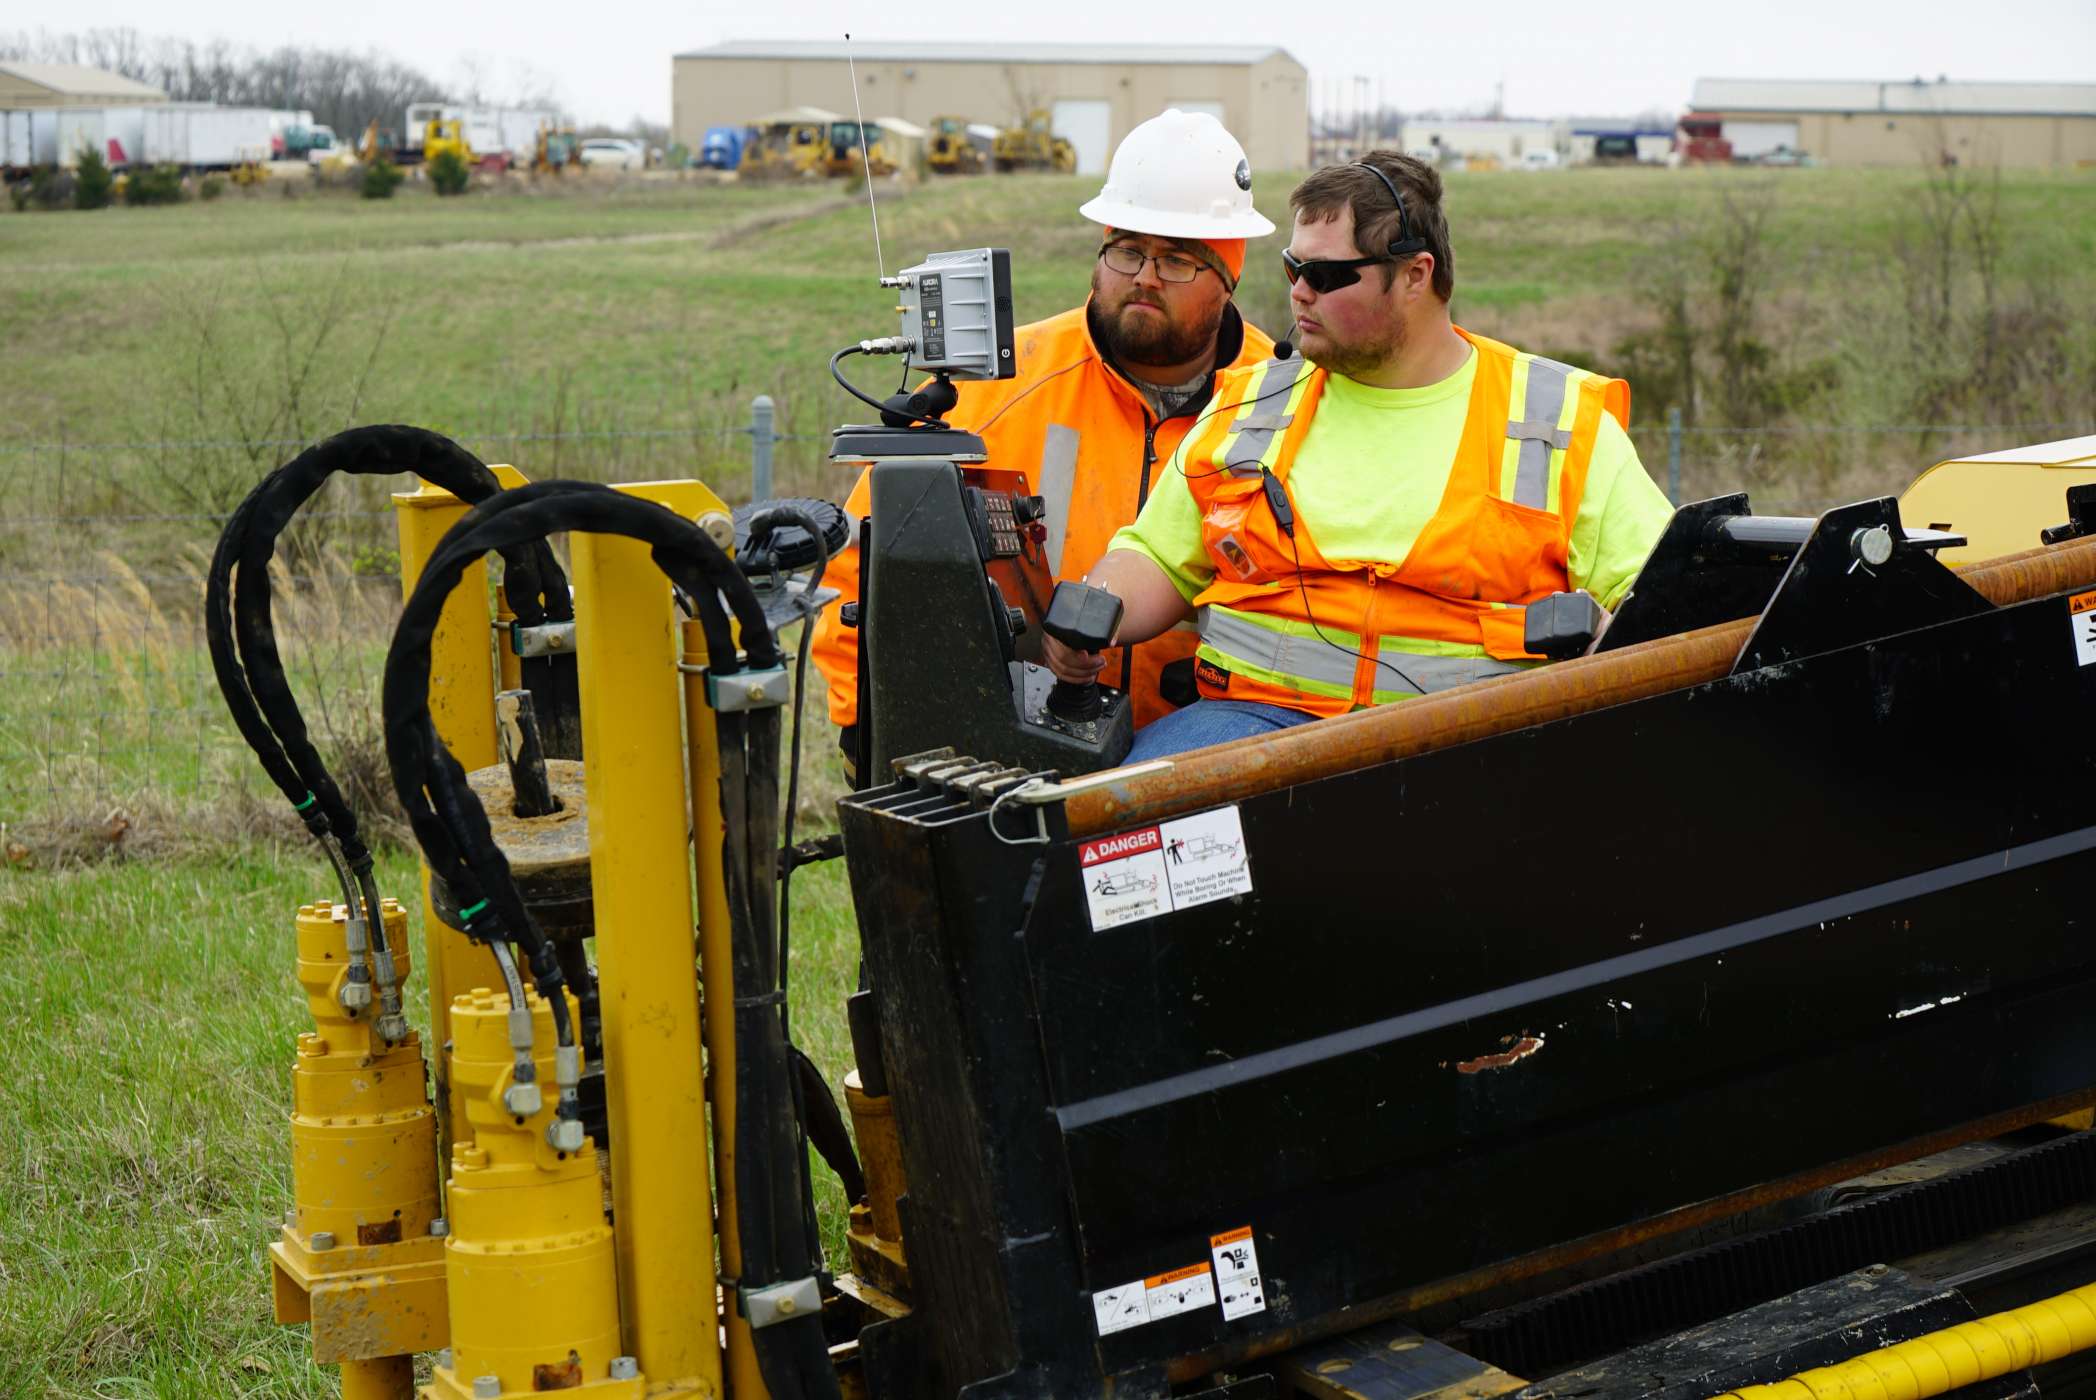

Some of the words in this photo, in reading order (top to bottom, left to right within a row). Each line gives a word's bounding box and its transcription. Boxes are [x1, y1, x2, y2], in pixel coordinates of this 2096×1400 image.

[1098, 830, 1158, 857] DANGER
[1173, 882, 1183, 890] Do
[1184, 878, 1196, 887] Not
[1196, 873, 1216, 883] Touch
[1217, 867, 1244, 878] Machine
[1174, 888, 1194, 897] While
[1194, 882, 1217, 892] Boring
[1218, 879, 1226, 887] Or
[1226, 875, 1246, 884] When
[1188, 893, 1208, 903] Alarm
[1119, 912, 1133, 921] Can
[1167, 1266, 1200, 1280] WARNING
